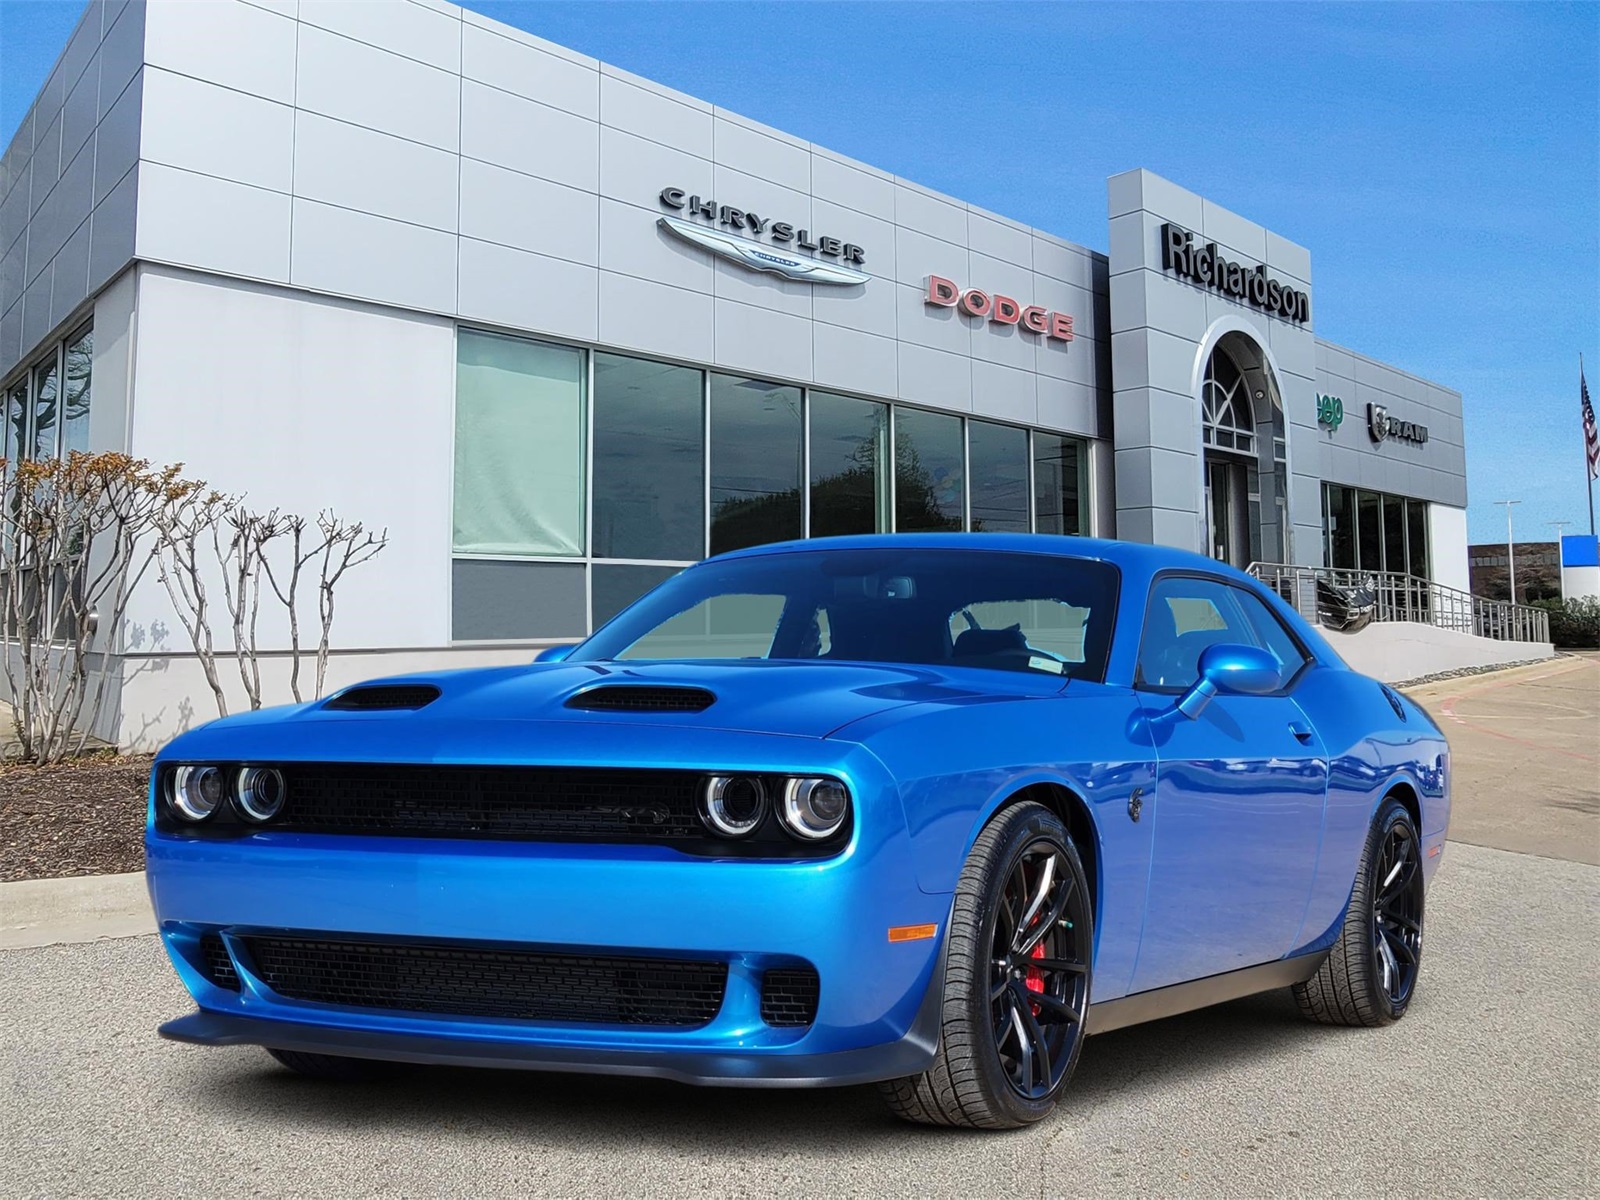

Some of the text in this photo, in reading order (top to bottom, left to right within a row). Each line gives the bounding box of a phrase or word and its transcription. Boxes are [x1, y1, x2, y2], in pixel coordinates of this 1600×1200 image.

[660, 187, 866, 264] CHRYSLER
[754, 251, 797, 267] CHRYSLER
[1161, 223, 1310, 323] Richardson
[923, 275, 1074, 342] DODGE
[1387, 416, 1429, 443] RAM
